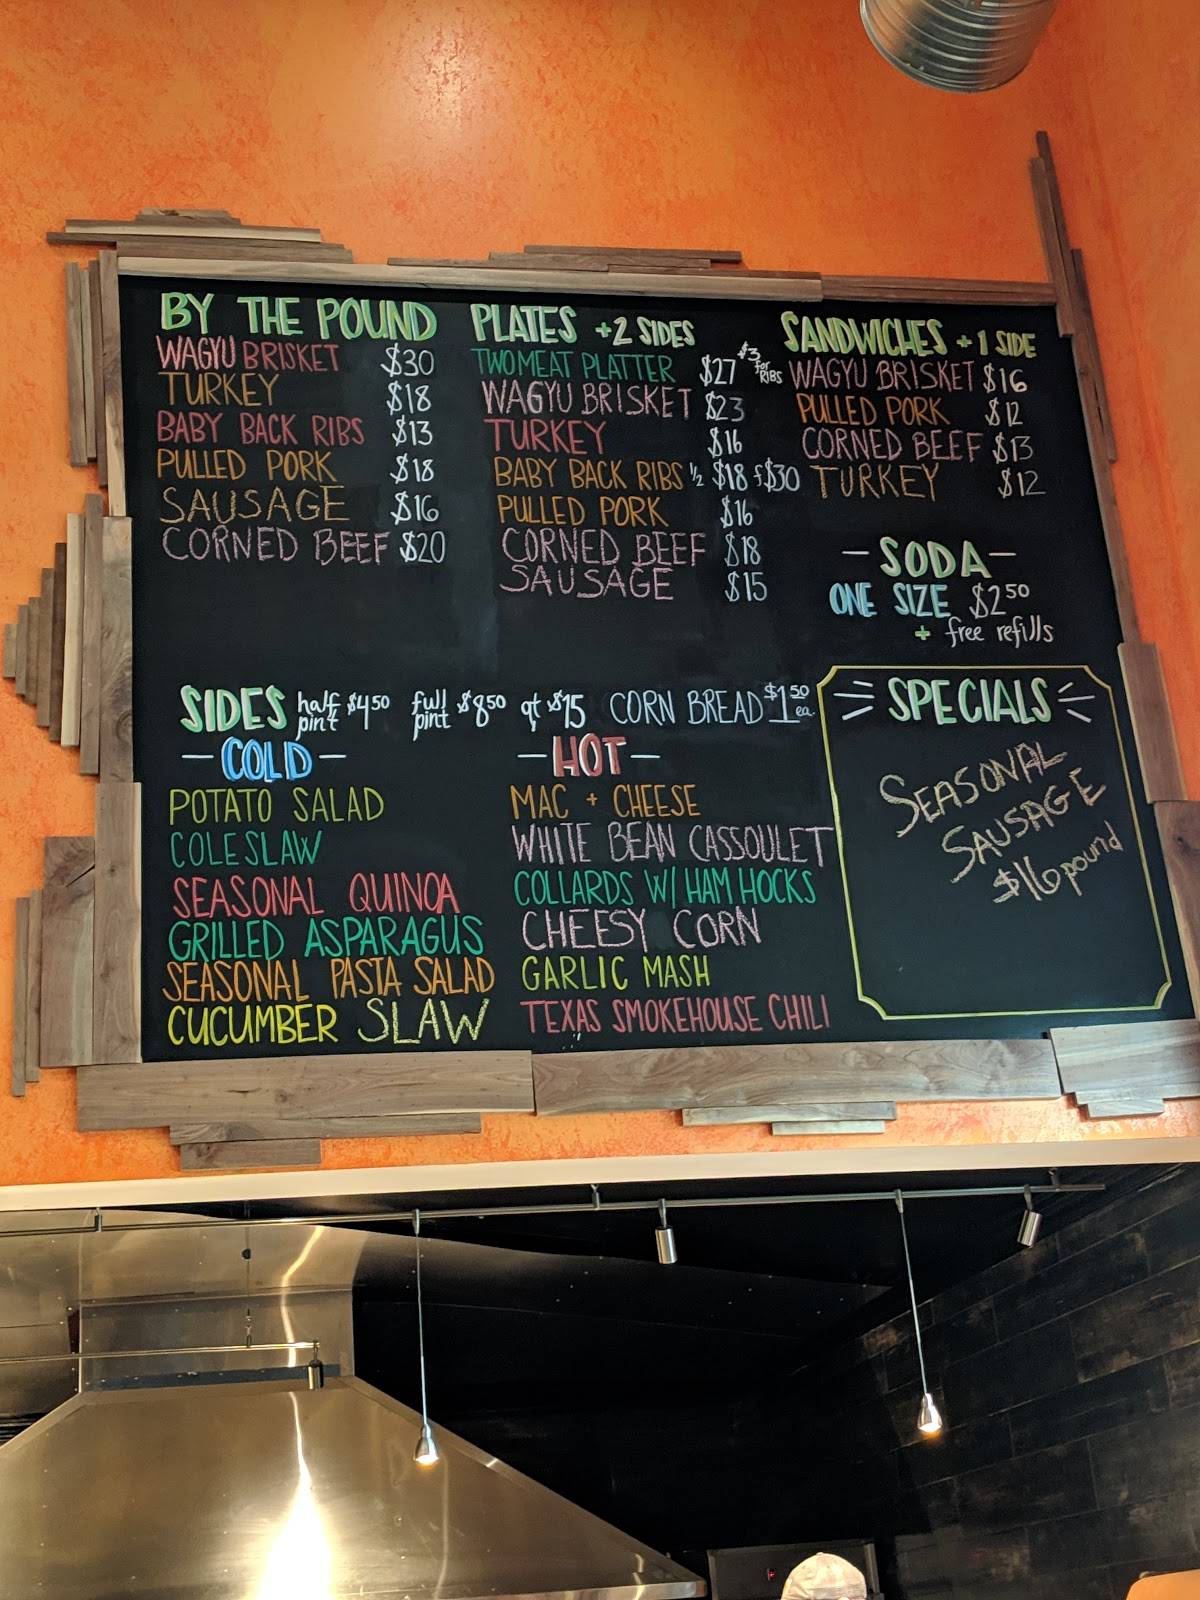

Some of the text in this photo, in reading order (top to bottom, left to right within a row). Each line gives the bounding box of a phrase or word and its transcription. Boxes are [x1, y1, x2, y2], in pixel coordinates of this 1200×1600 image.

[160, 291, 438, 341] BY THE POUND
[469, 303, 578, 343] PLATES
[637, 316, 696, 348] SIDES
[780, 310, 948, 357] SANDWICHES
[995, 329, 1037, 359] SIDE
[155, 334, 435, 378] WAGYU BRISKET $30
[581, 351, 677, 383] PLATTER
[699, 354, 737, 387] $27
[736, 340, 761, 361] $3
[754, 359, 771, 374] for
[158, 371, 432, 416] TURKEY $18
[759, 369, 783, 384] RIBS
[787, 357, 1028, 394] WAGYU BRISKET $16
[481, 379, 746, 423] WAGYU BRISKET $23
[796, 392, 1024, 427] PULLED PORK $12
[155, 409, 434, 448] BABY BACK RIBS $13
[483, 417, 743, 459] TURKEY $16
[801, 427, 1034, 464] CORNED BEEF $13
[156, 448, 435, 484] PULLED PORK $18
[493, 456, 557, 488] BABY
[568, 458, 627, 490] BACK
[636, 459, 684, 491] RIBS
[711, 458, 749, 492] $18
[809, 462, 1046, 502] TURKEY $12
[159, 485, 440, 526] SAUSAGE $16
[496, 494, 753, 528] PULLED PORK $16
[161, 524, 446, 566] CORNED BEEF $20
[501, 527, 762, 568] CORNED BEEF $18
[879, 536, 992, 579] SODA
[498, 564, 768, 602] SAUSAGE $15
[829, 581, 877, 618] ONE
[892, 581, 953, 619] SIZE
[944, 616, 985, 648] free
[996, 613, 1054, 649] refills
[180, 684, 288, 733] SIDES
[297, 689, 342, 722] half
[411, 688, 447, 716] full
[547, 689, 586, 729] $15
[609, 689, 676, 726] CORN
[687, 688, 763, 725] BREAD
[888, 676, 1052, 725] SPECIALS
[295, 708, 339, 742] pint
[412, 710, 452, 742] pint
[221, 735, 313, 783] COLD
[552, 732, 627, 778] HOT
[168, 786, 385, 825] POTATO SALAD
[509, 783, 701, 820] MAC + CHEESE
[878, 740, 1068, 838] SEASONAL
[510, 820, 833, 868] WHITE BEAN CASSOULET
[941, 767, 1107, 884] SAUSAGE
[170, 829, 323, 868] COLESLAW
[992, 820, 1124, 904] $16 pound
[172, 872, 461, 918] SEASONAL QUINOA
[513, 865, 817, 909] COLLARDS W/ HAM HOCKS
[168, 914, 485, 963] GRILLED ASPARAGUS
[521, 905, 762, 953] CHEESY CORN
[161, 955, 496, 1003] SEASONAL PASTA SALAD
[520, 954, 711, 991] GARLIC MASH
[166, 996, 490, 1046] CUCUMBER SLAW
[519, 993, 830, 1034] TEXAS SMOKEHOUSE CHILI
